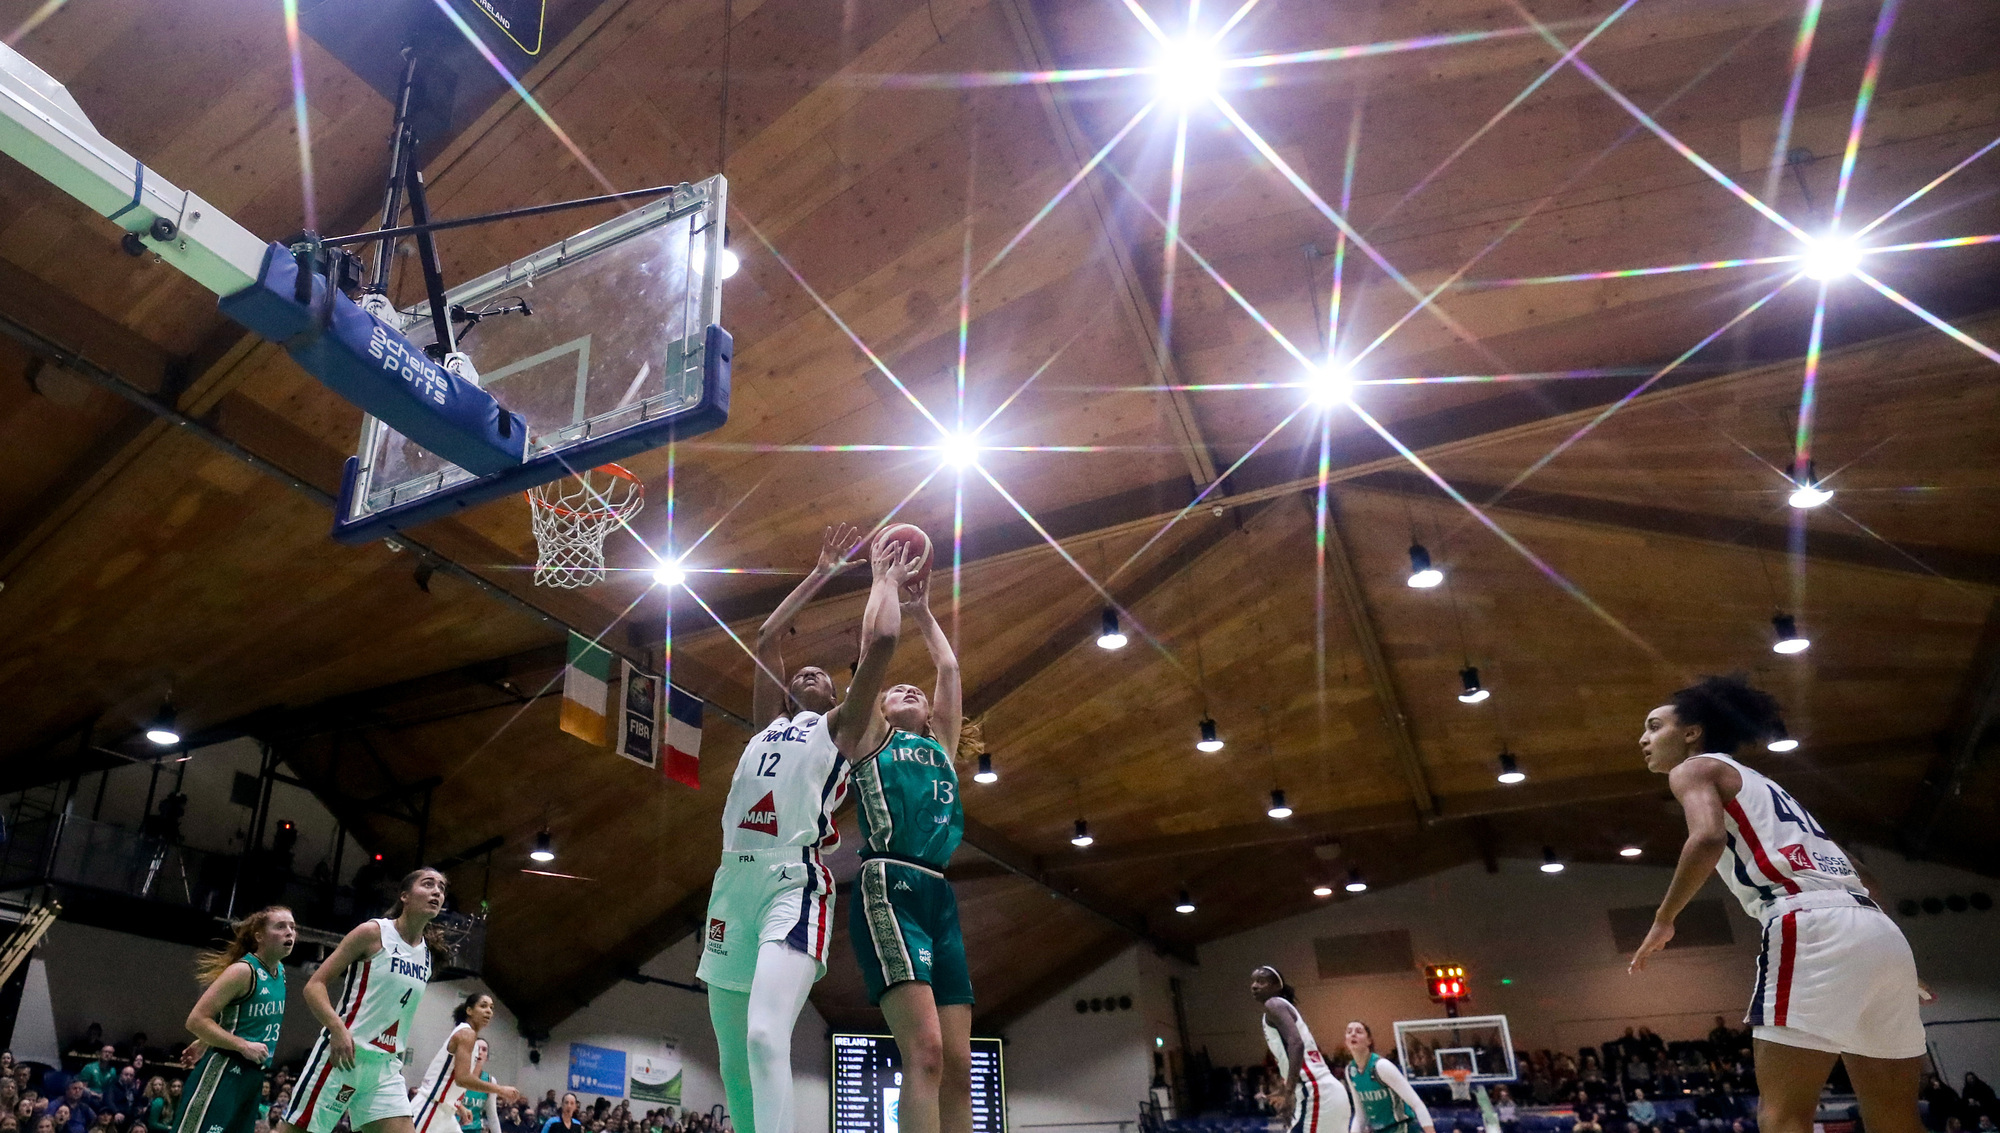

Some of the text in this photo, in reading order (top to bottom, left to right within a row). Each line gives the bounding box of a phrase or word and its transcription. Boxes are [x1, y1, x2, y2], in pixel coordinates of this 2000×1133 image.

[479, 0, 511, 29] RELAND
[372, 326, 449, 392] Schelde
[368, 339, 446, 405] Sports
[630, 718, 650, 740] FIBA
[761, 725, 810, 744] RANCE
[757, 752, 781, 777] 12
[931, 779, 954, 804] 13
[743, 811, 777, 825] MAIF
[739, 855, 755, 863] FRA
[390, 957, 428, 983] FRANCE
[400, 988, 413, 1008] 4
[263, 1023, 281, 1042] 23
[377, 1034, 397, 1047] MAIF
[835, 1037, 868, 1046] IRELAND
[886, 1057, 892, 1068] 1
[894, 1071, 903, 1086] 8
